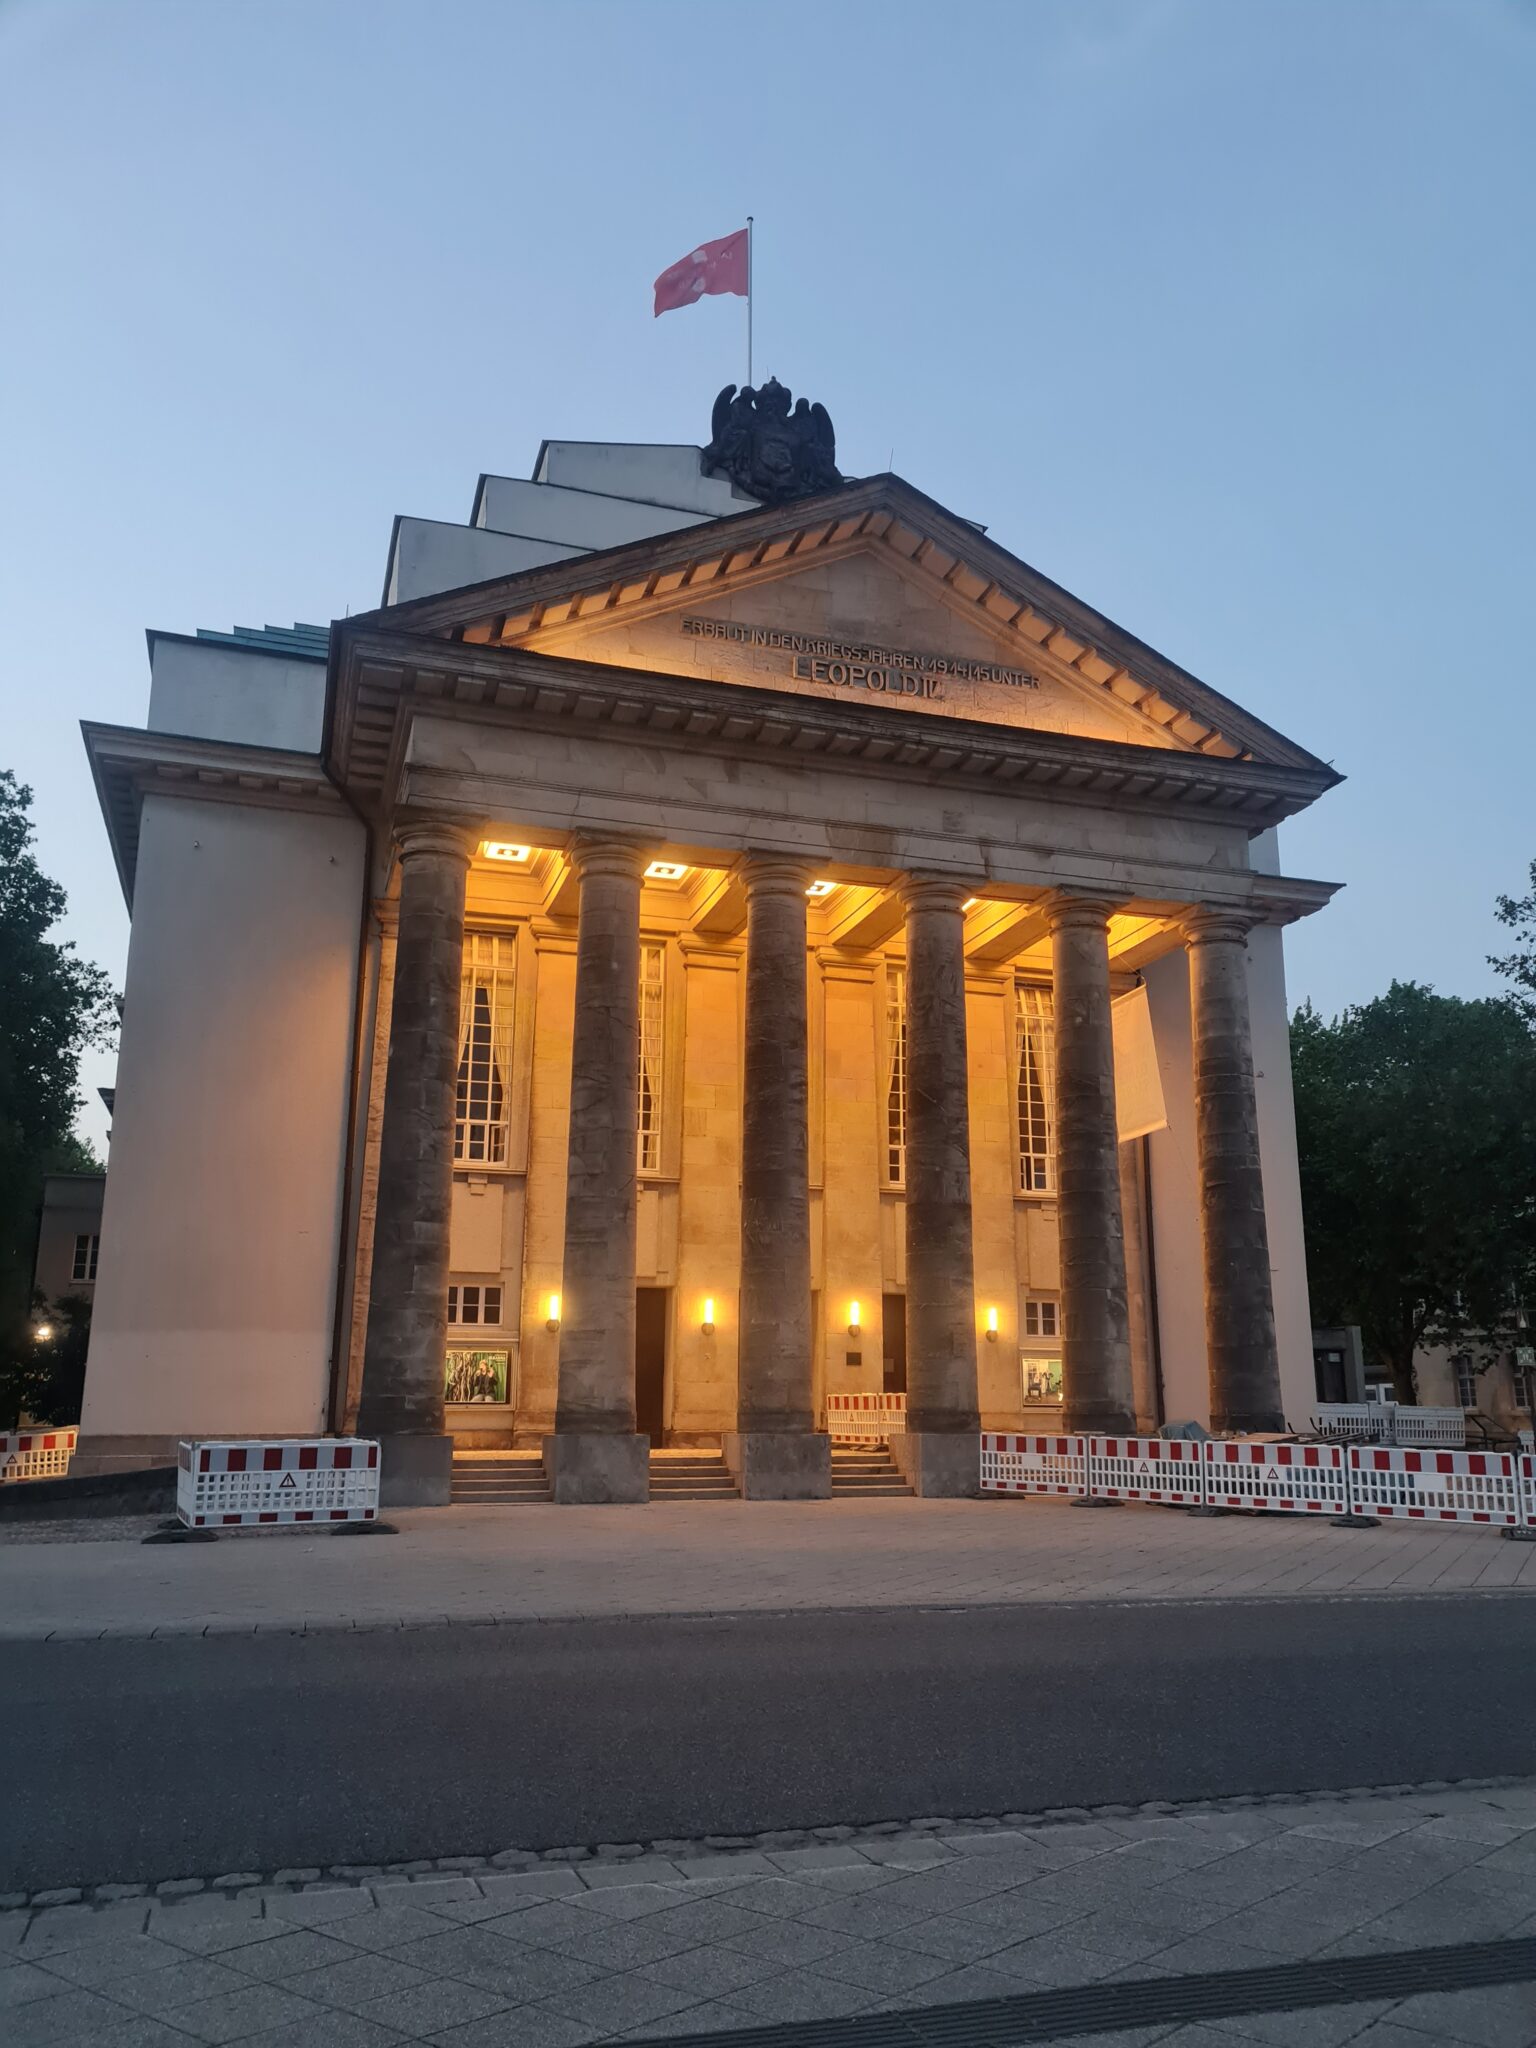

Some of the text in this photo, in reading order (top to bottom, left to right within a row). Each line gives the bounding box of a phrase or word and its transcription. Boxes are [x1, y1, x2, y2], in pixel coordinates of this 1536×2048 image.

[683, 619, 748, 641] ERBAUT
[751, 629, 767, 646] IN
[769, 634, 803, 651] DEN
[805, 639, 925, 670] KRIEGSJAHREN
[991, 670, 1040, 690] UNTER
[792, 655, 920, 696] LEOPOLD
